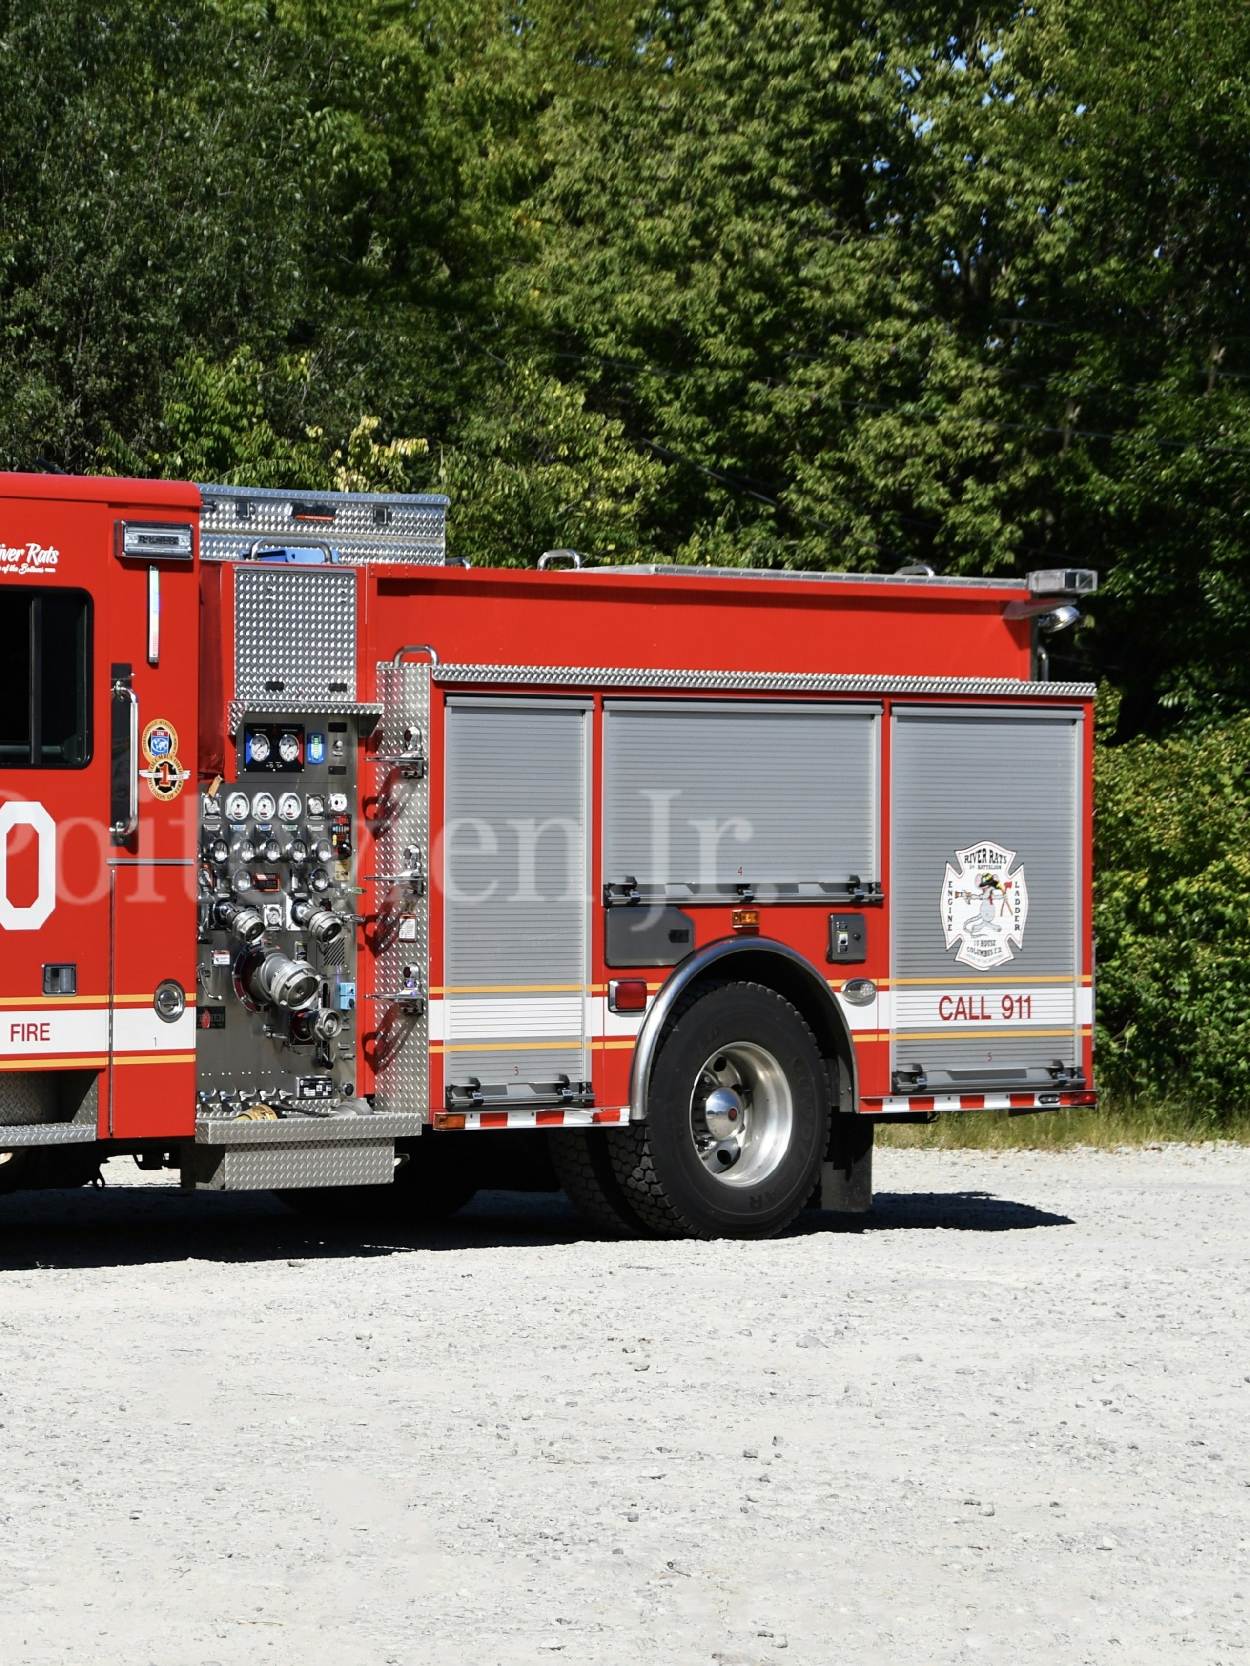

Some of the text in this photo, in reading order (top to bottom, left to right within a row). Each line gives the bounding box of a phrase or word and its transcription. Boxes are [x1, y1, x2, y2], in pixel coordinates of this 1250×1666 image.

[25, 543, 60, 566] Rats
[159, 763, 170, 786] 1
[964, 848, 1007, 864] RIVER RATS
[737, 866, 743, 876] 4
[980, 939, 997, 947] HOUSE
[966, 946, 994, 957] COLUMBUS
[938, 994, 1032, 1020] CALL 911
[9, 1022, 51, 1043] FIRE
[153, 1036, 157, 1047] 1
[513, 1065, 519, 1076] 3
